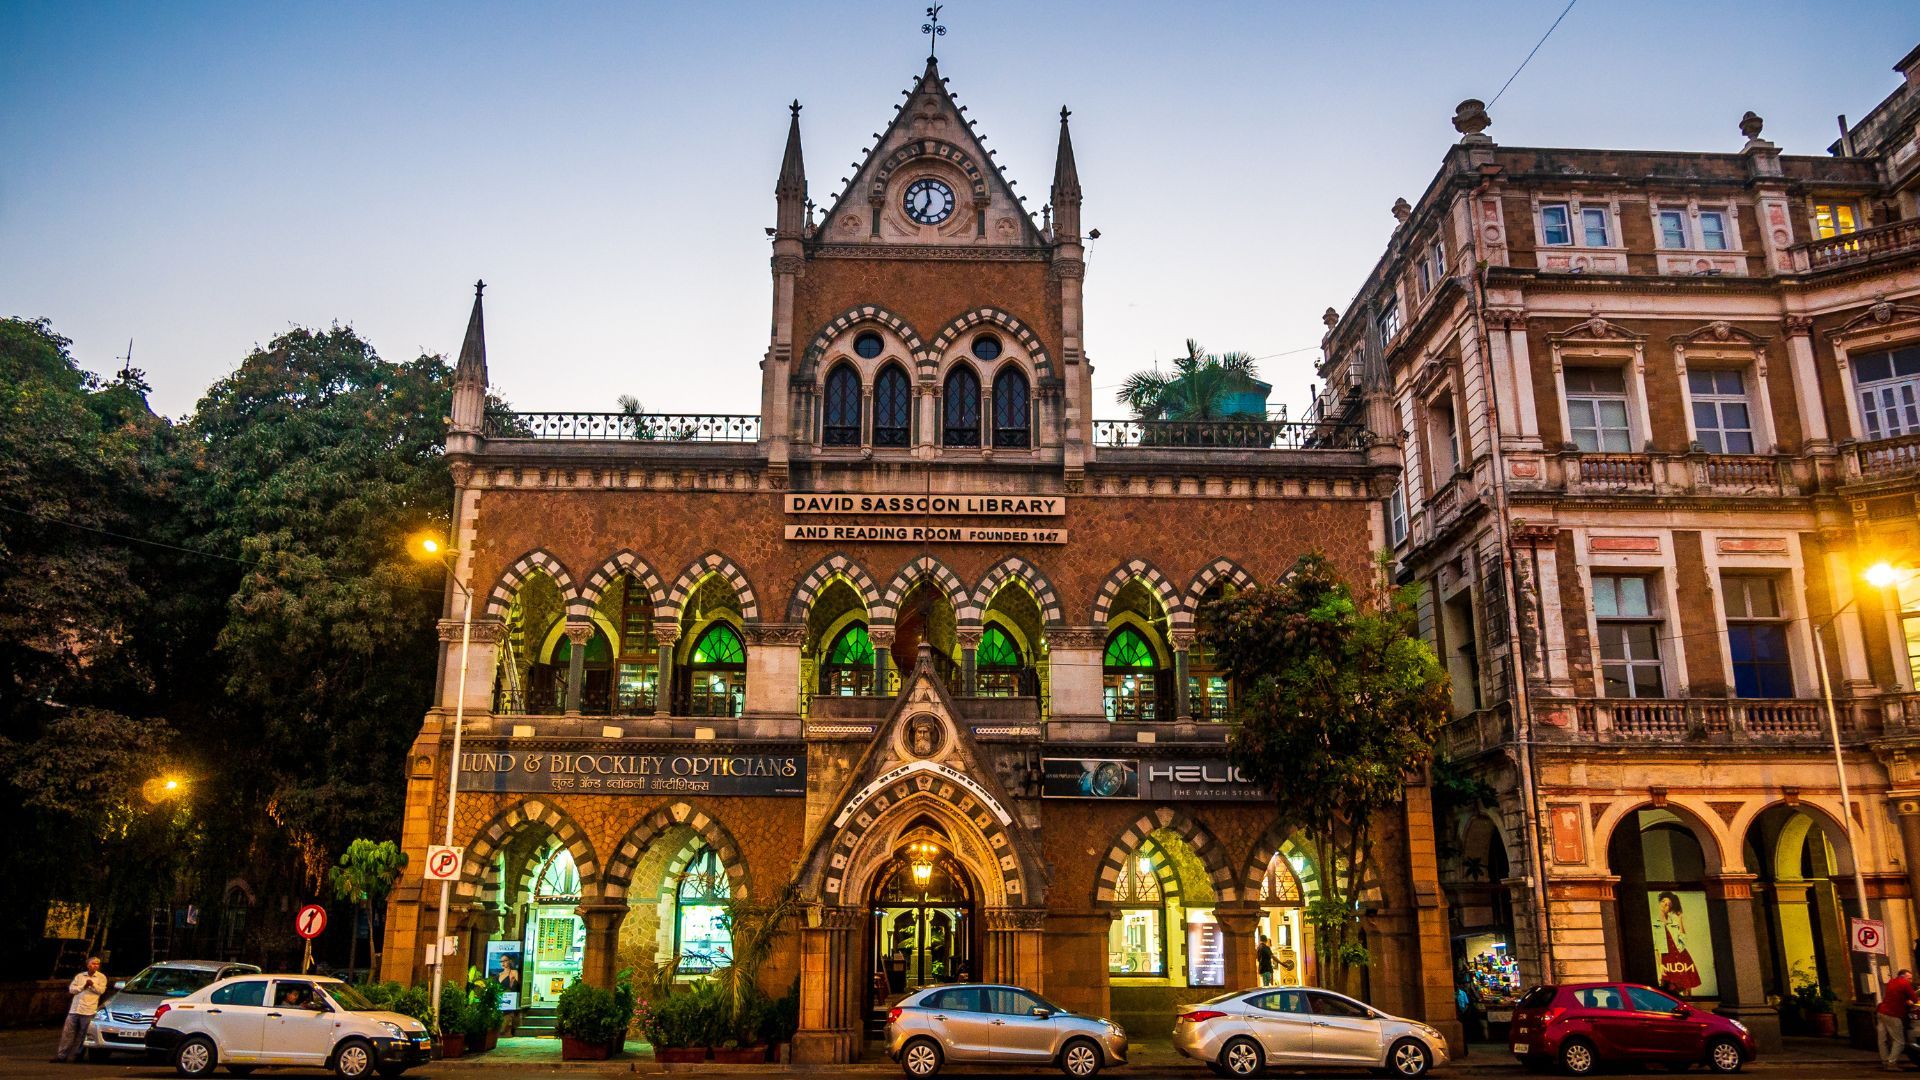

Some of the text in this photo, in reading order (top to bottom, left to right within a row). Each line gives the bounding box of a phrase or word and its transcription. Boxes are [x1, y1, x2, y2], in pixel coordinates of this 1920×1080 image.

[793, 498, 1057, 513] DAVID SASSOON LIBRARY
[795, 527, 1059, 542] AND READING ROOM FOUNDED 1847
[461, 753, 797, 777] LUND & BLOCKLEY OPTICIANS
